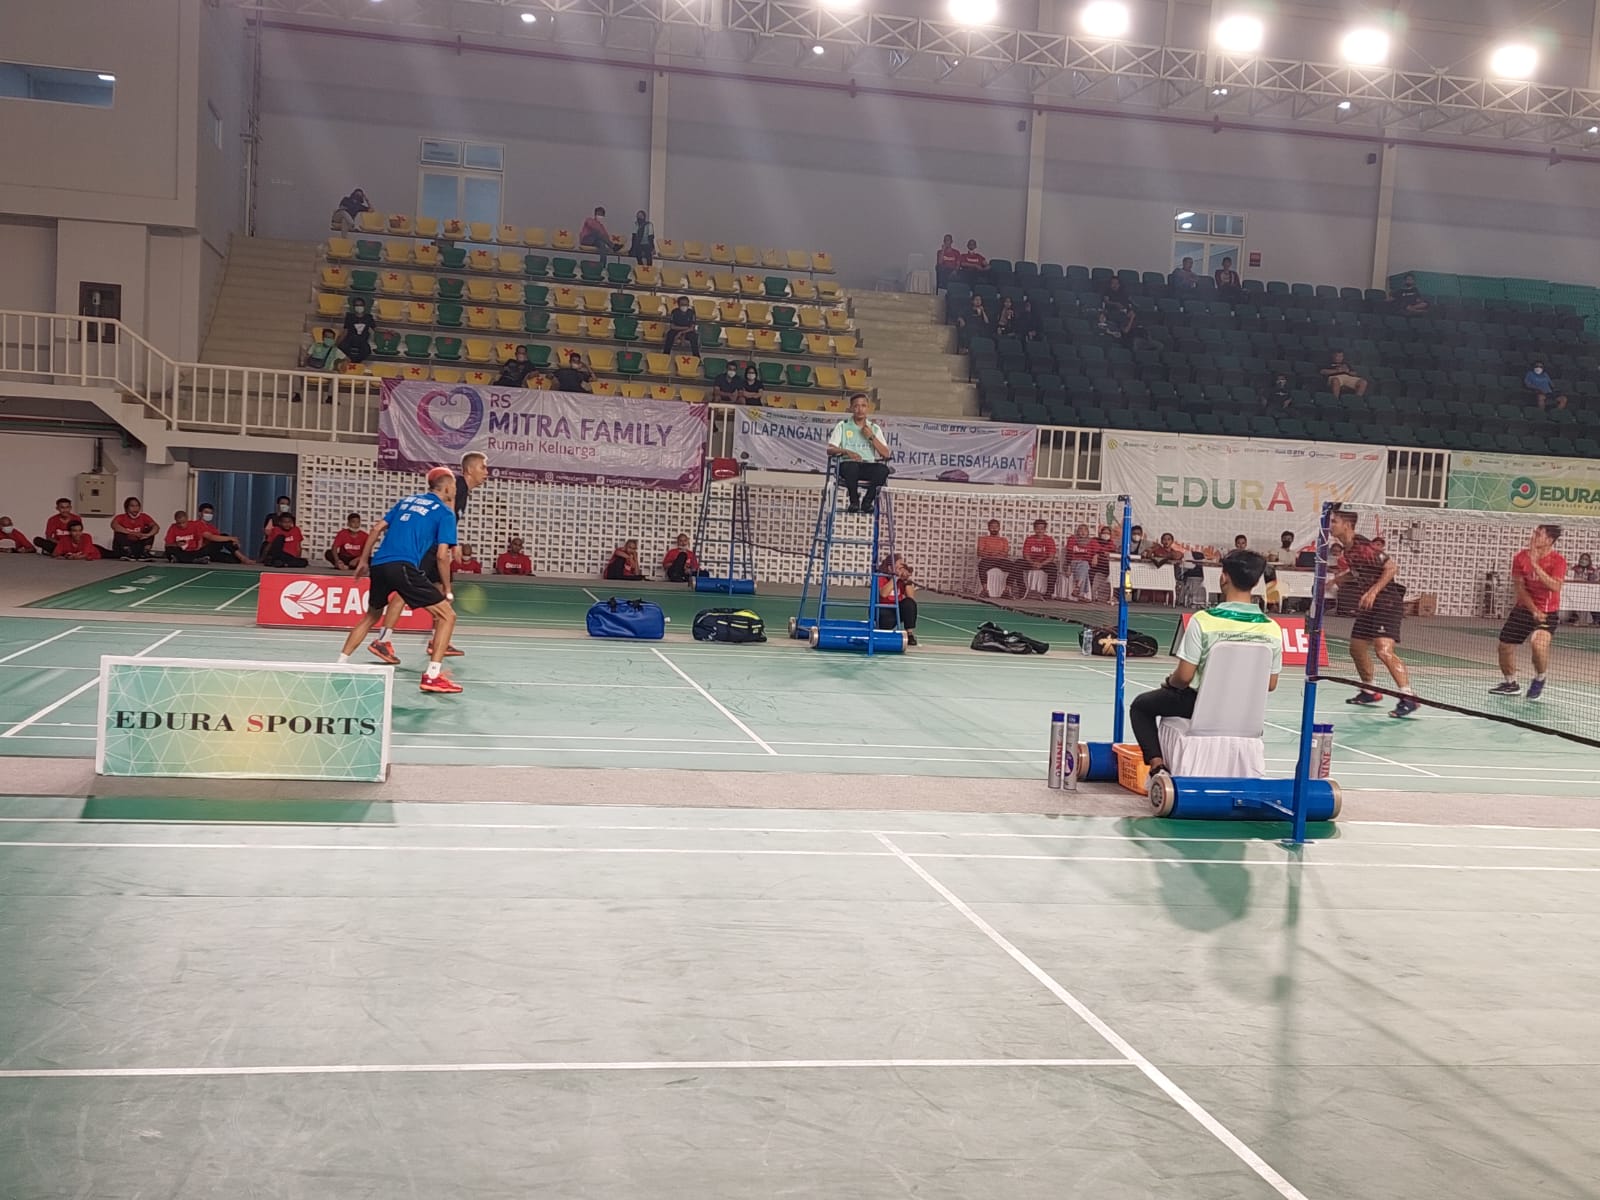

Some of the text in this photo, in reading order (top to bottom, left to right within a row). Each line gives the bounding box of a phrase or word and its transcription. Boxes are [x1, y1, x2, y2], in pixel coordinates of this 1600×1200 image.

[490, 393, 511, 409] RS
[488, 410, 673, 447] MITRA FAMILY
[741, 421, 822, 441] DILAPANGAN
[950, 425, 967, 433] BTN
[488, 438, 596, 459] Rumah Keluarga
[909, 452, 937, 466] KITA
[940, 453, 1026, 471] BERSAHABAT
[1155, 475, 1295, 512] EDURA
[1540, 486, 1600, 504] EDURA
[115, 710, 376, 736] EDURA SPORTS
